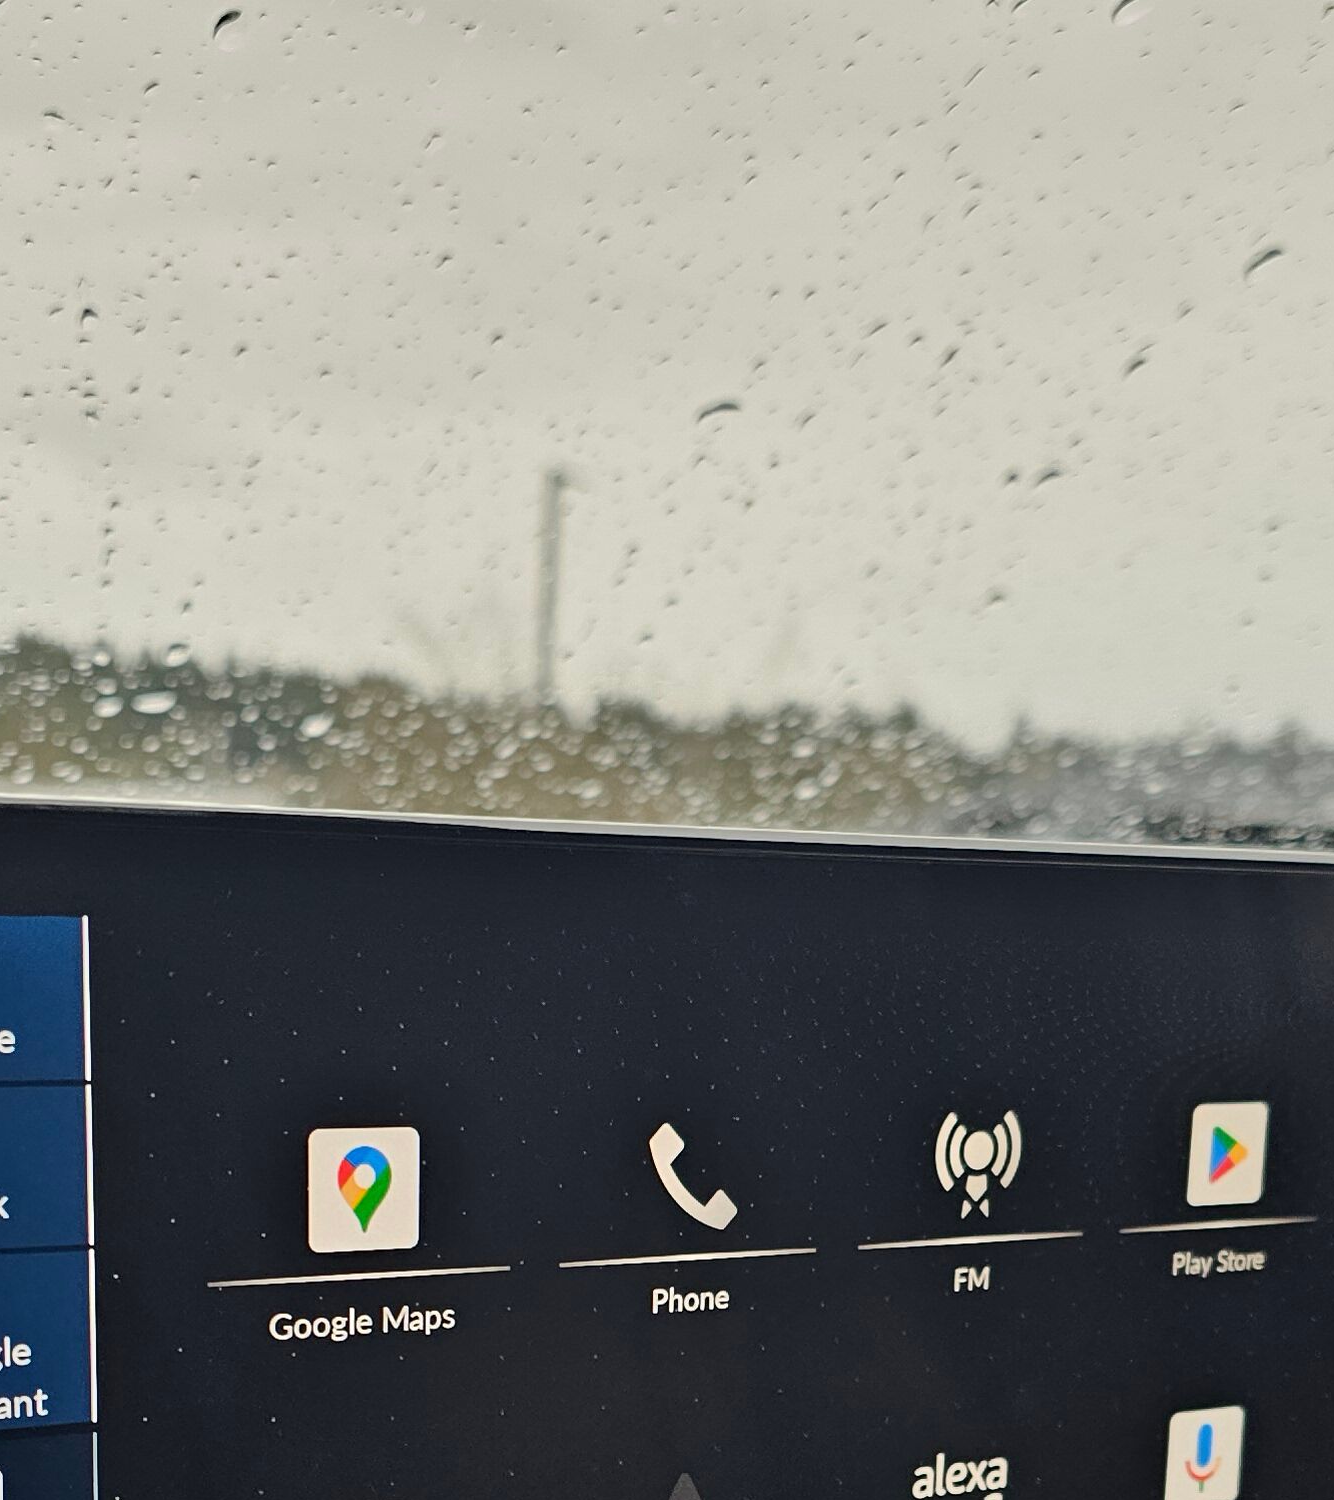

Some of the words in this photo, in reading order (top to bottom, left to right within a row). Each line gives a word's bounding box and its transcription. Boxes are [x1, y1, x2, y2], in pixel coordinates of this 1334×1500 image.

[953, 1265, 991, 1293] FM
[1172, 1251, 1214, 1279] Play
[1216, 1249, 1266, 1273] Store
[652, 1286, 730, 1315] Phone
[268, 1307, 373, 1342] Google
[382, 1305, 456, 1336] Maps
[911, 1452, 1008, 1499] alexa
